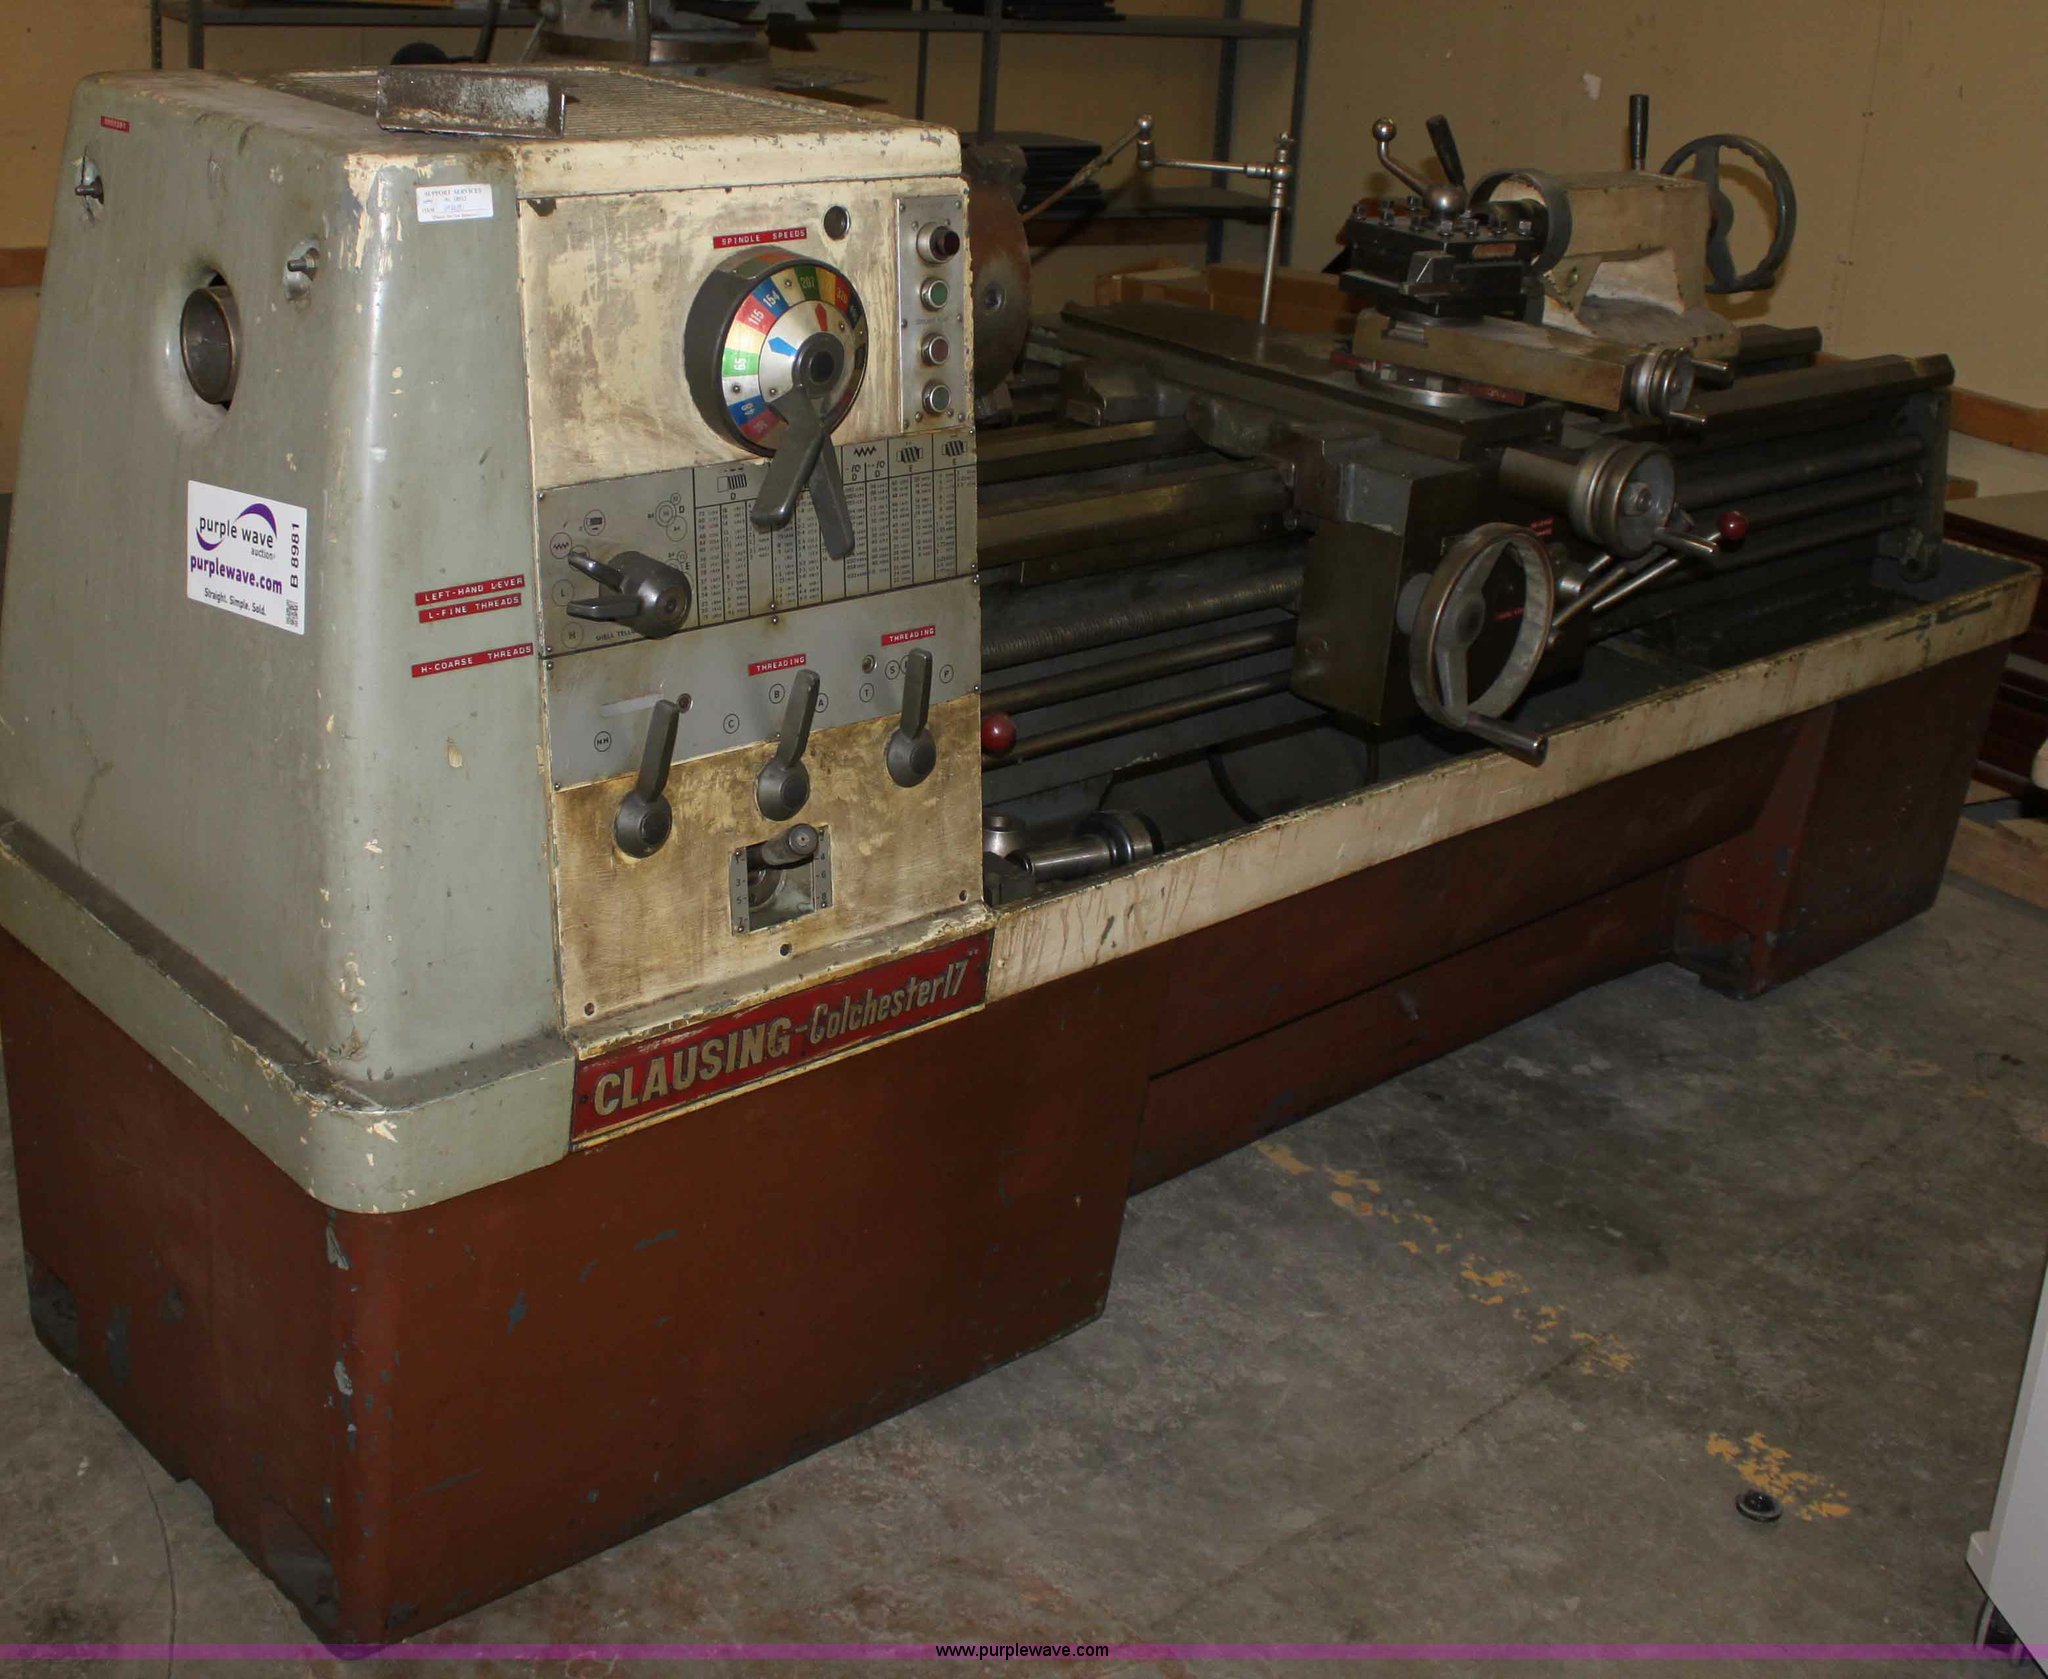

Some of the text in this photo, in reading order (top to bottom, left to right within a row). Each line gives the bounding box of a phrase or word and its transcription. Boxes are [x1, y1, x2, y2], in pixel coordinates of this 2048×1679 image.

[721, 230, 805, 246] SPINDLE SPEEDS
[762, 291, 780, 308] 154
[748, 308, 764, 326] 115
[734, 358, 747, 370] 65
[200, 516, 274, 549] purple wave
[290, 523, 300, 588] B 8981
[190, 555, 282, 595] purplewave.com
[424, 577, 523, 602] LEFT-HAND LEVER
[230, 595, 250, 612] Simple.
[252, 603, 267, 616] Sold.
[428, 596, 519, 619] L-FINE THREADS
[889, 628, 934, 642] THREADING
[420, 646, 532, 674] H-COARSE THREADS
[756, 656, 805, 672] THREADING
